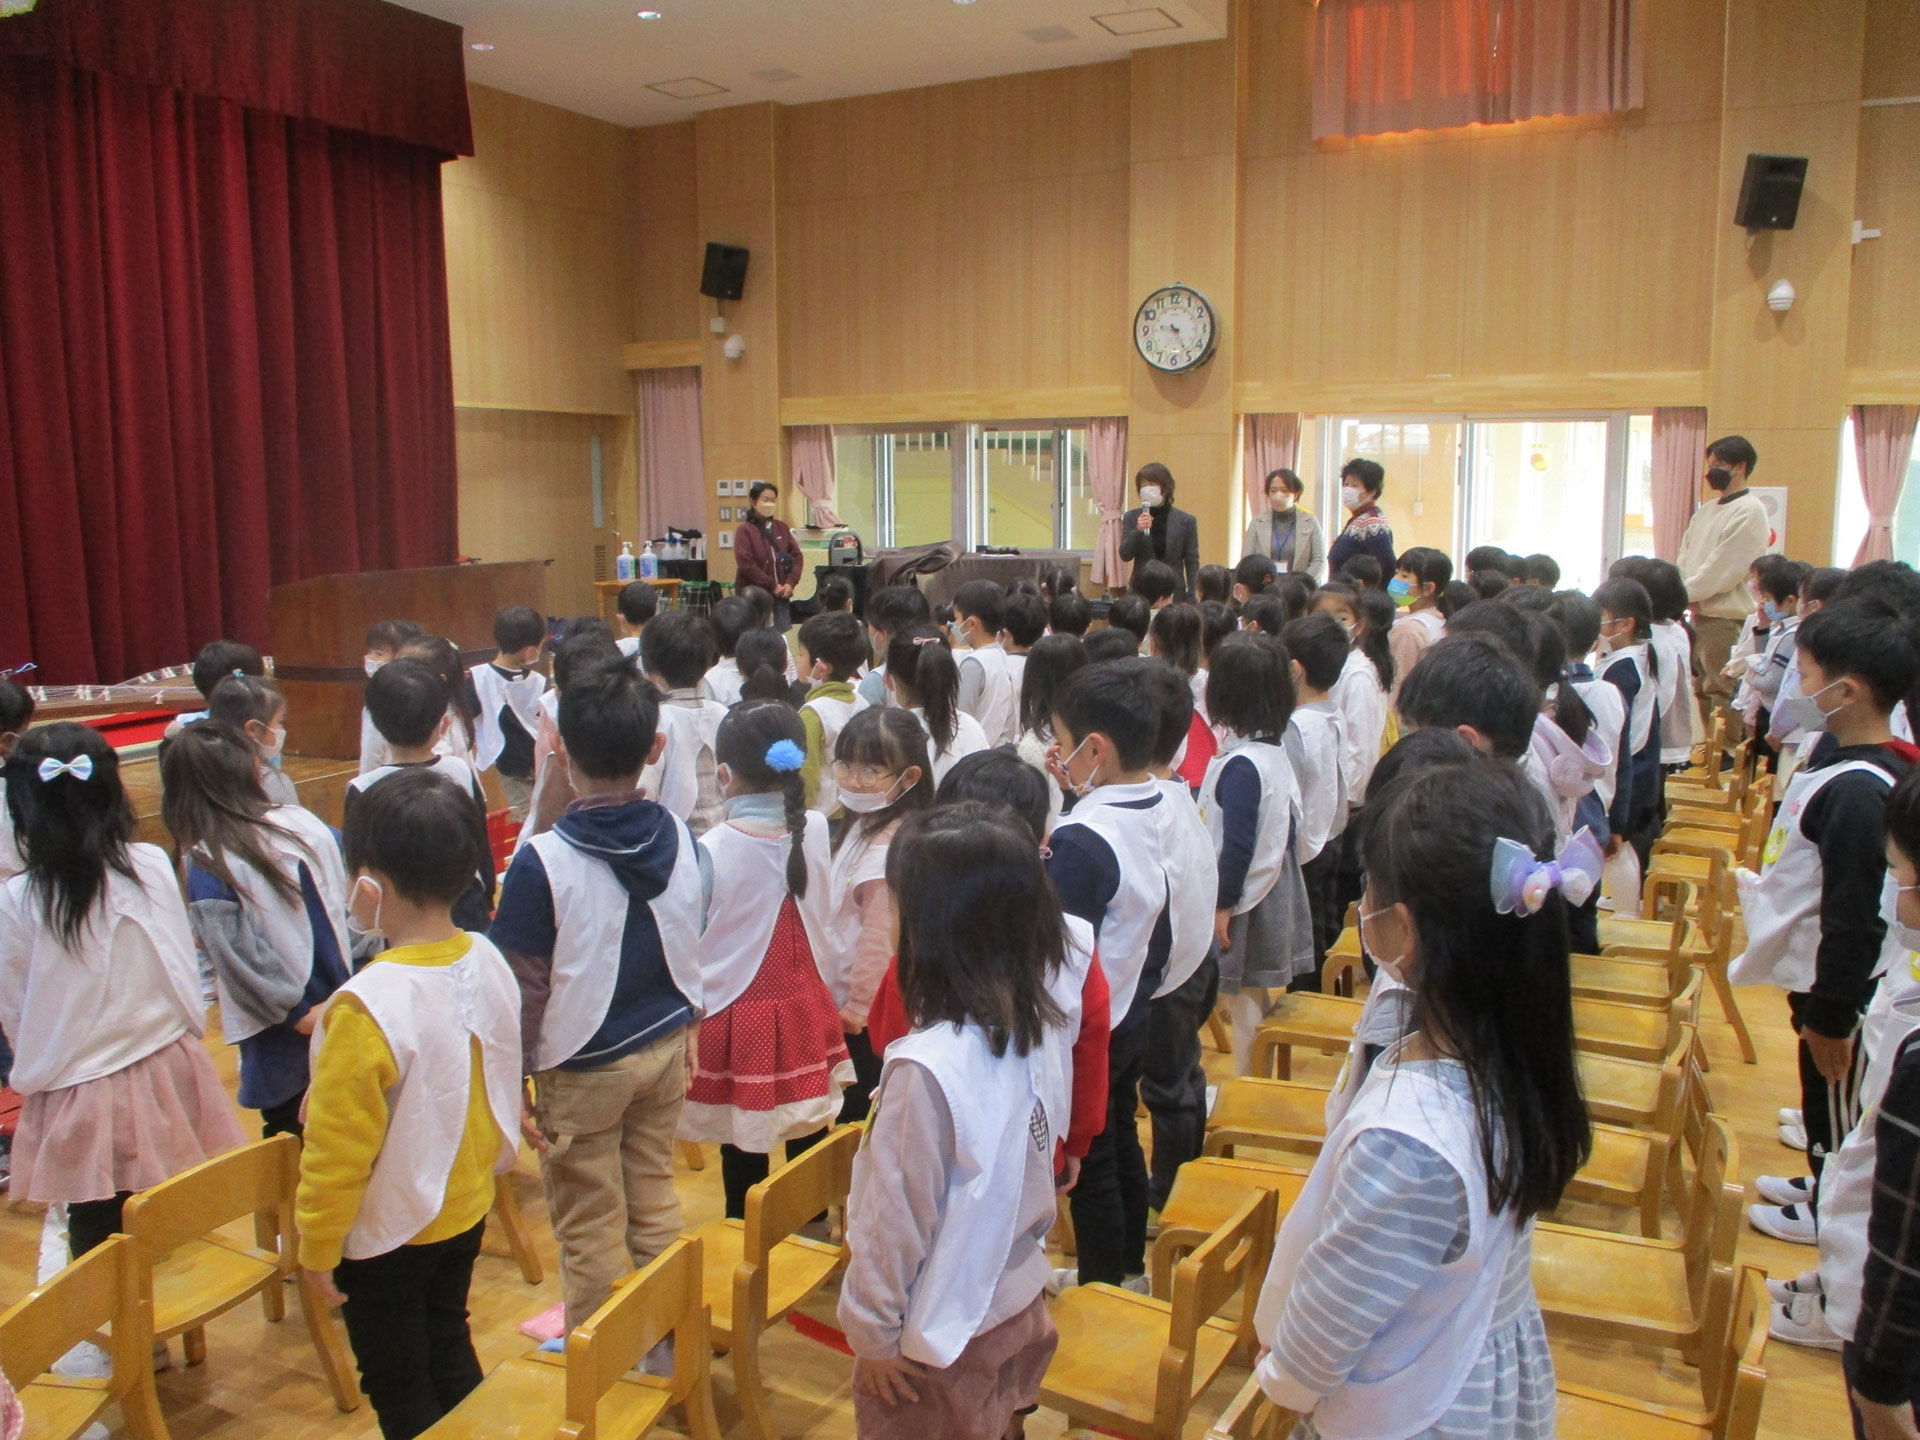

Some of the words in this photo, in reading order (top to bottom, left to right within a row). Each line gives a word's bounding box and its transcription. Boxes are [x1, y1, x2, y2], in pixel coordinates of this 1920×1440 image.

[1170, 292, 1180, 304] 12
[1156, 299, 1164, 309] 11
[1196, 306, 1204, 318] 2
[1142, 325, 1150, 336] 9
[1146, 340, 1153, 351] 8
[1195, 339, 1203, 349] 4
[1156, 352, 1163, 363] 7
[1170, 354, 1178, 366] 6
[1185, 350, 1192, 362] 5
